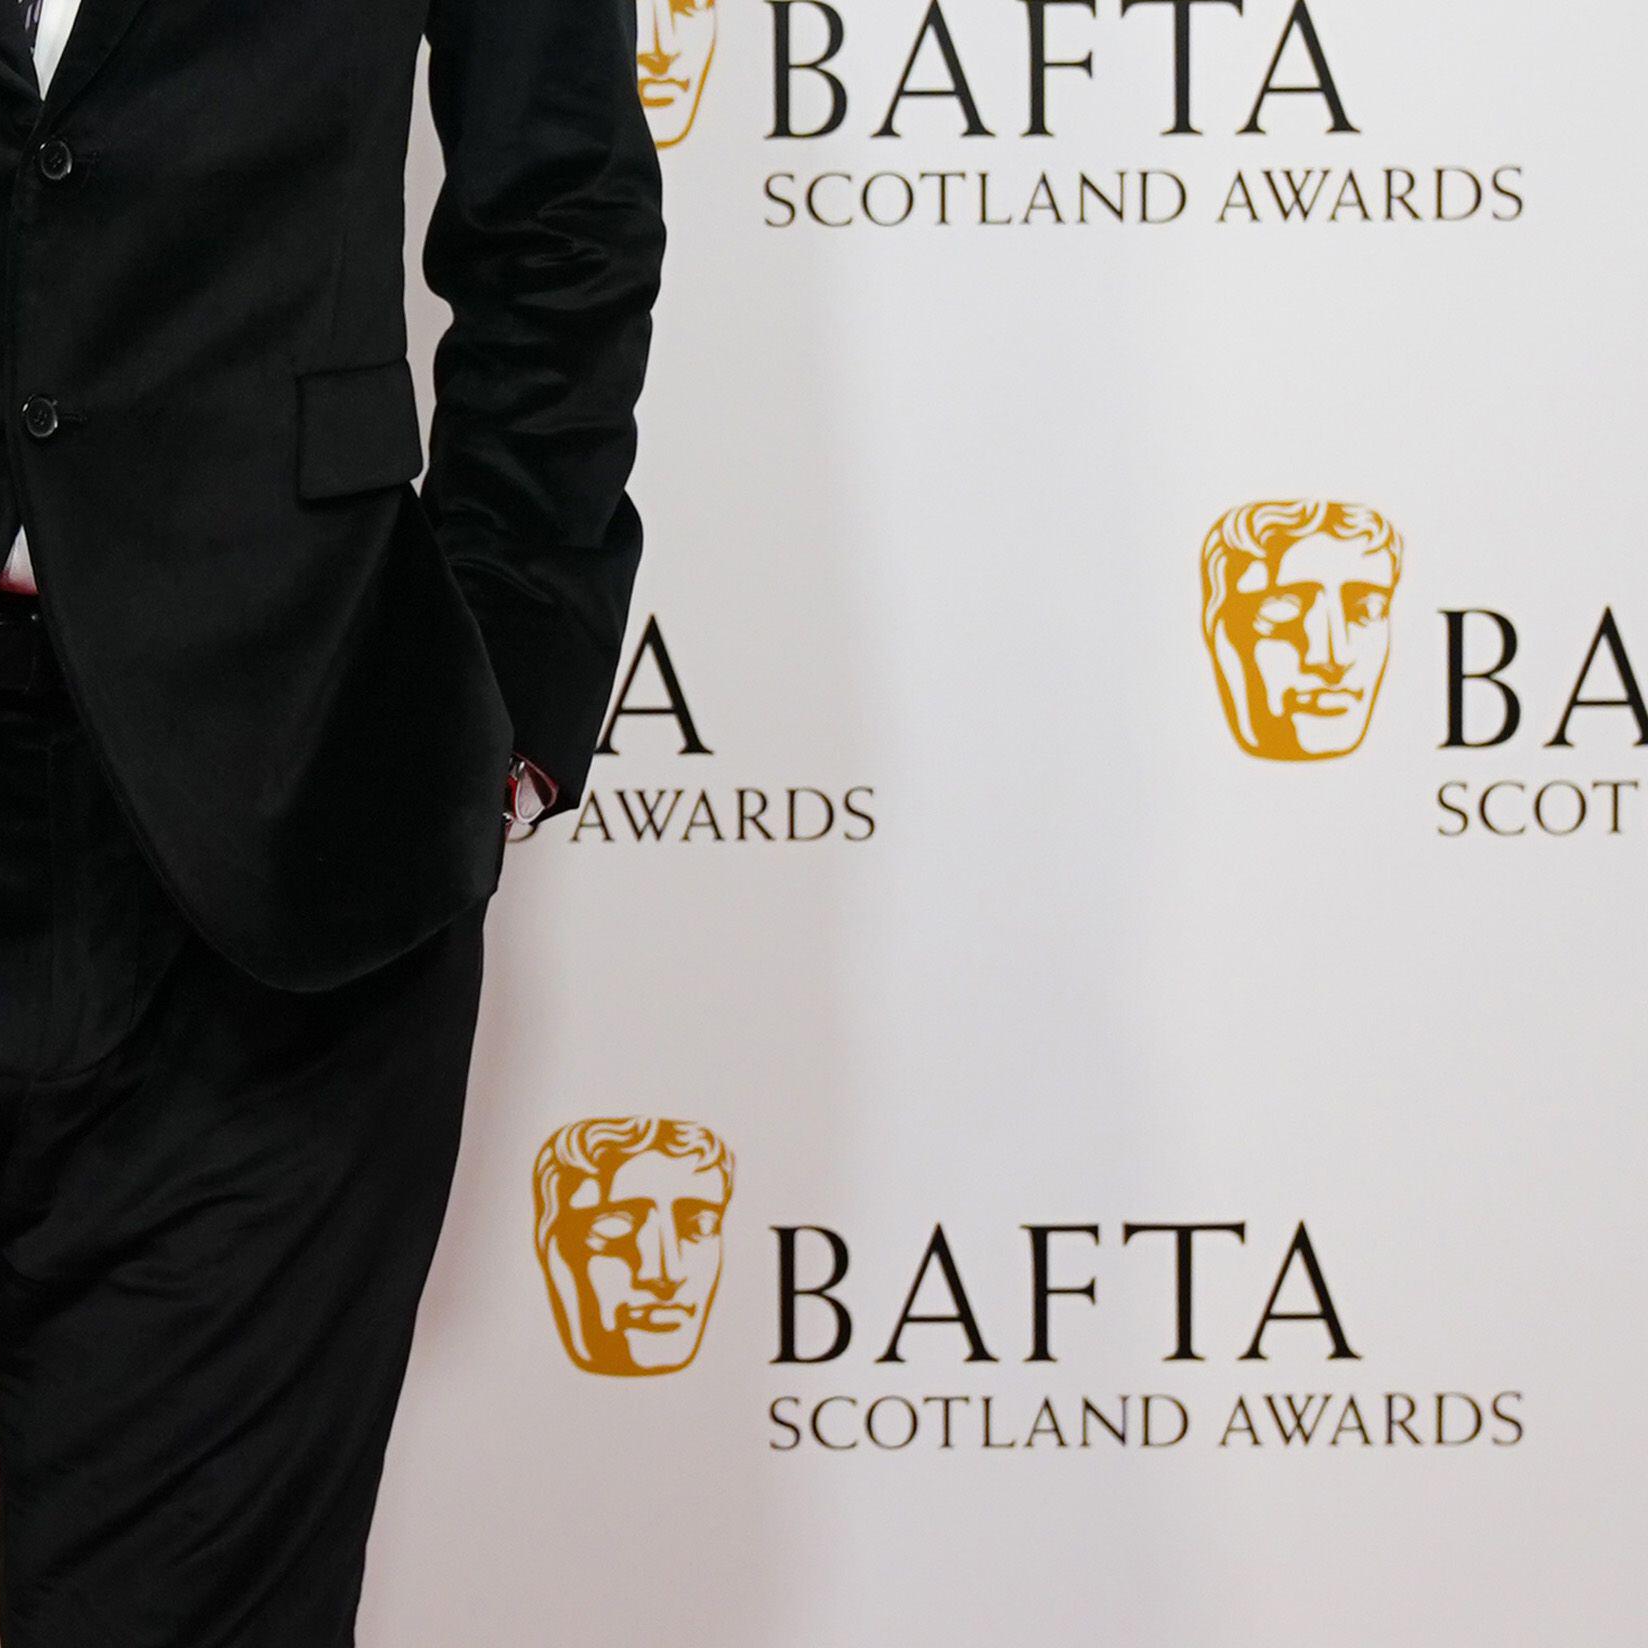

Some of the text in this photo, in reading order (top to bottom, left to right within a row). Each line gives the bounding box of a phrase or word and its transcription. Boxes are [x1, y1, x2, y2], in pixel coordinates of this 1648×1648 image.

[763, 167, 1525, 227] SCOTLAND AWARDS
[569, 786, 877, 843] AWARDS
[768, 1220, 1363, 1366] BAFTA
[768, 1391, 1525, 1451] SCOTLAND AWARDS
